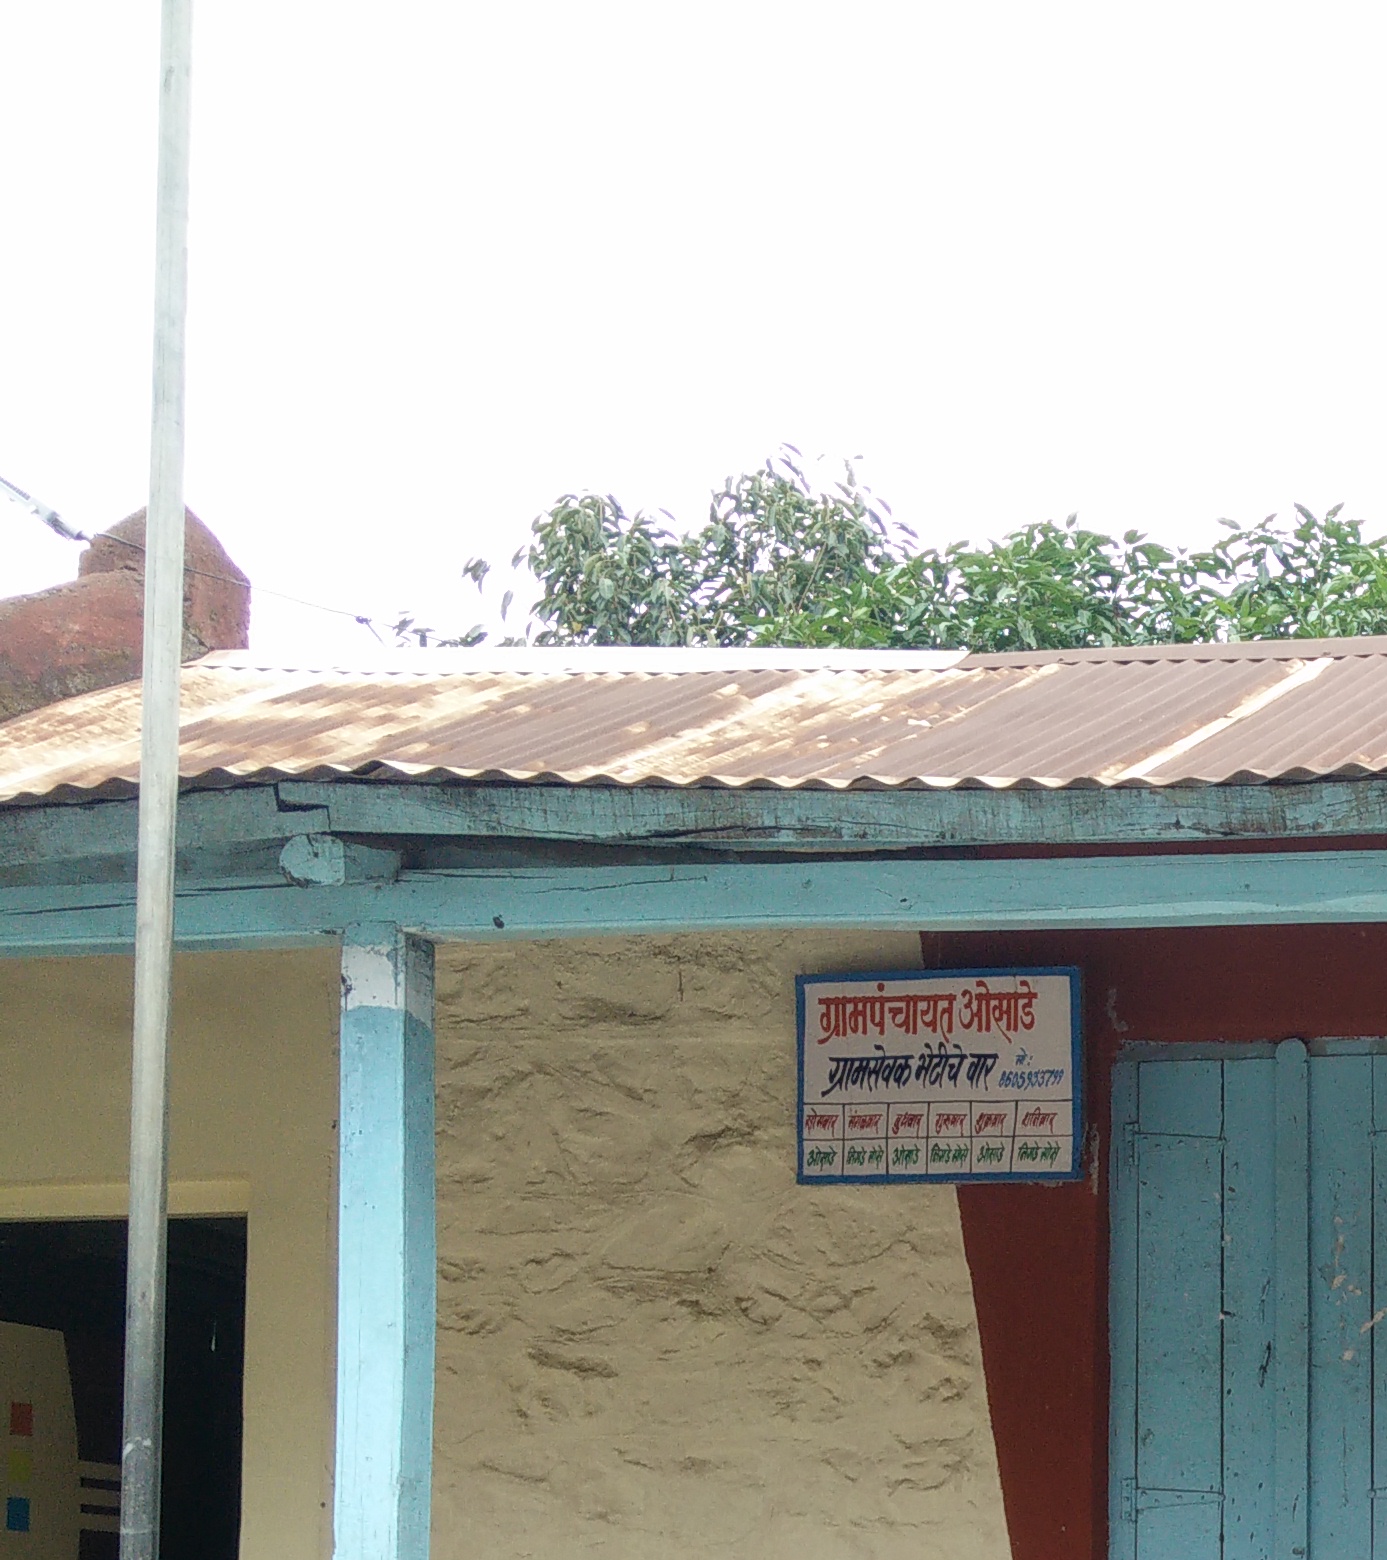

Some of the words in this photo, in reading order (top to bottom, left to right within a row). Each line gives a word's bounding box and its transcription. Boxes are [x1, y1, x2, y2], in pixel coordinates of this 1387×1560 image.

[817, 983, 956, 1044] ग्रामपंचायत
[959, 980, 1038, 1044] ओसाडे
[821, 1044, 915, 1098] ग्रामसेवक
[915, 1042, 969, 1090] भेटीचे
[968, 1052, 1000, 1091] वार
